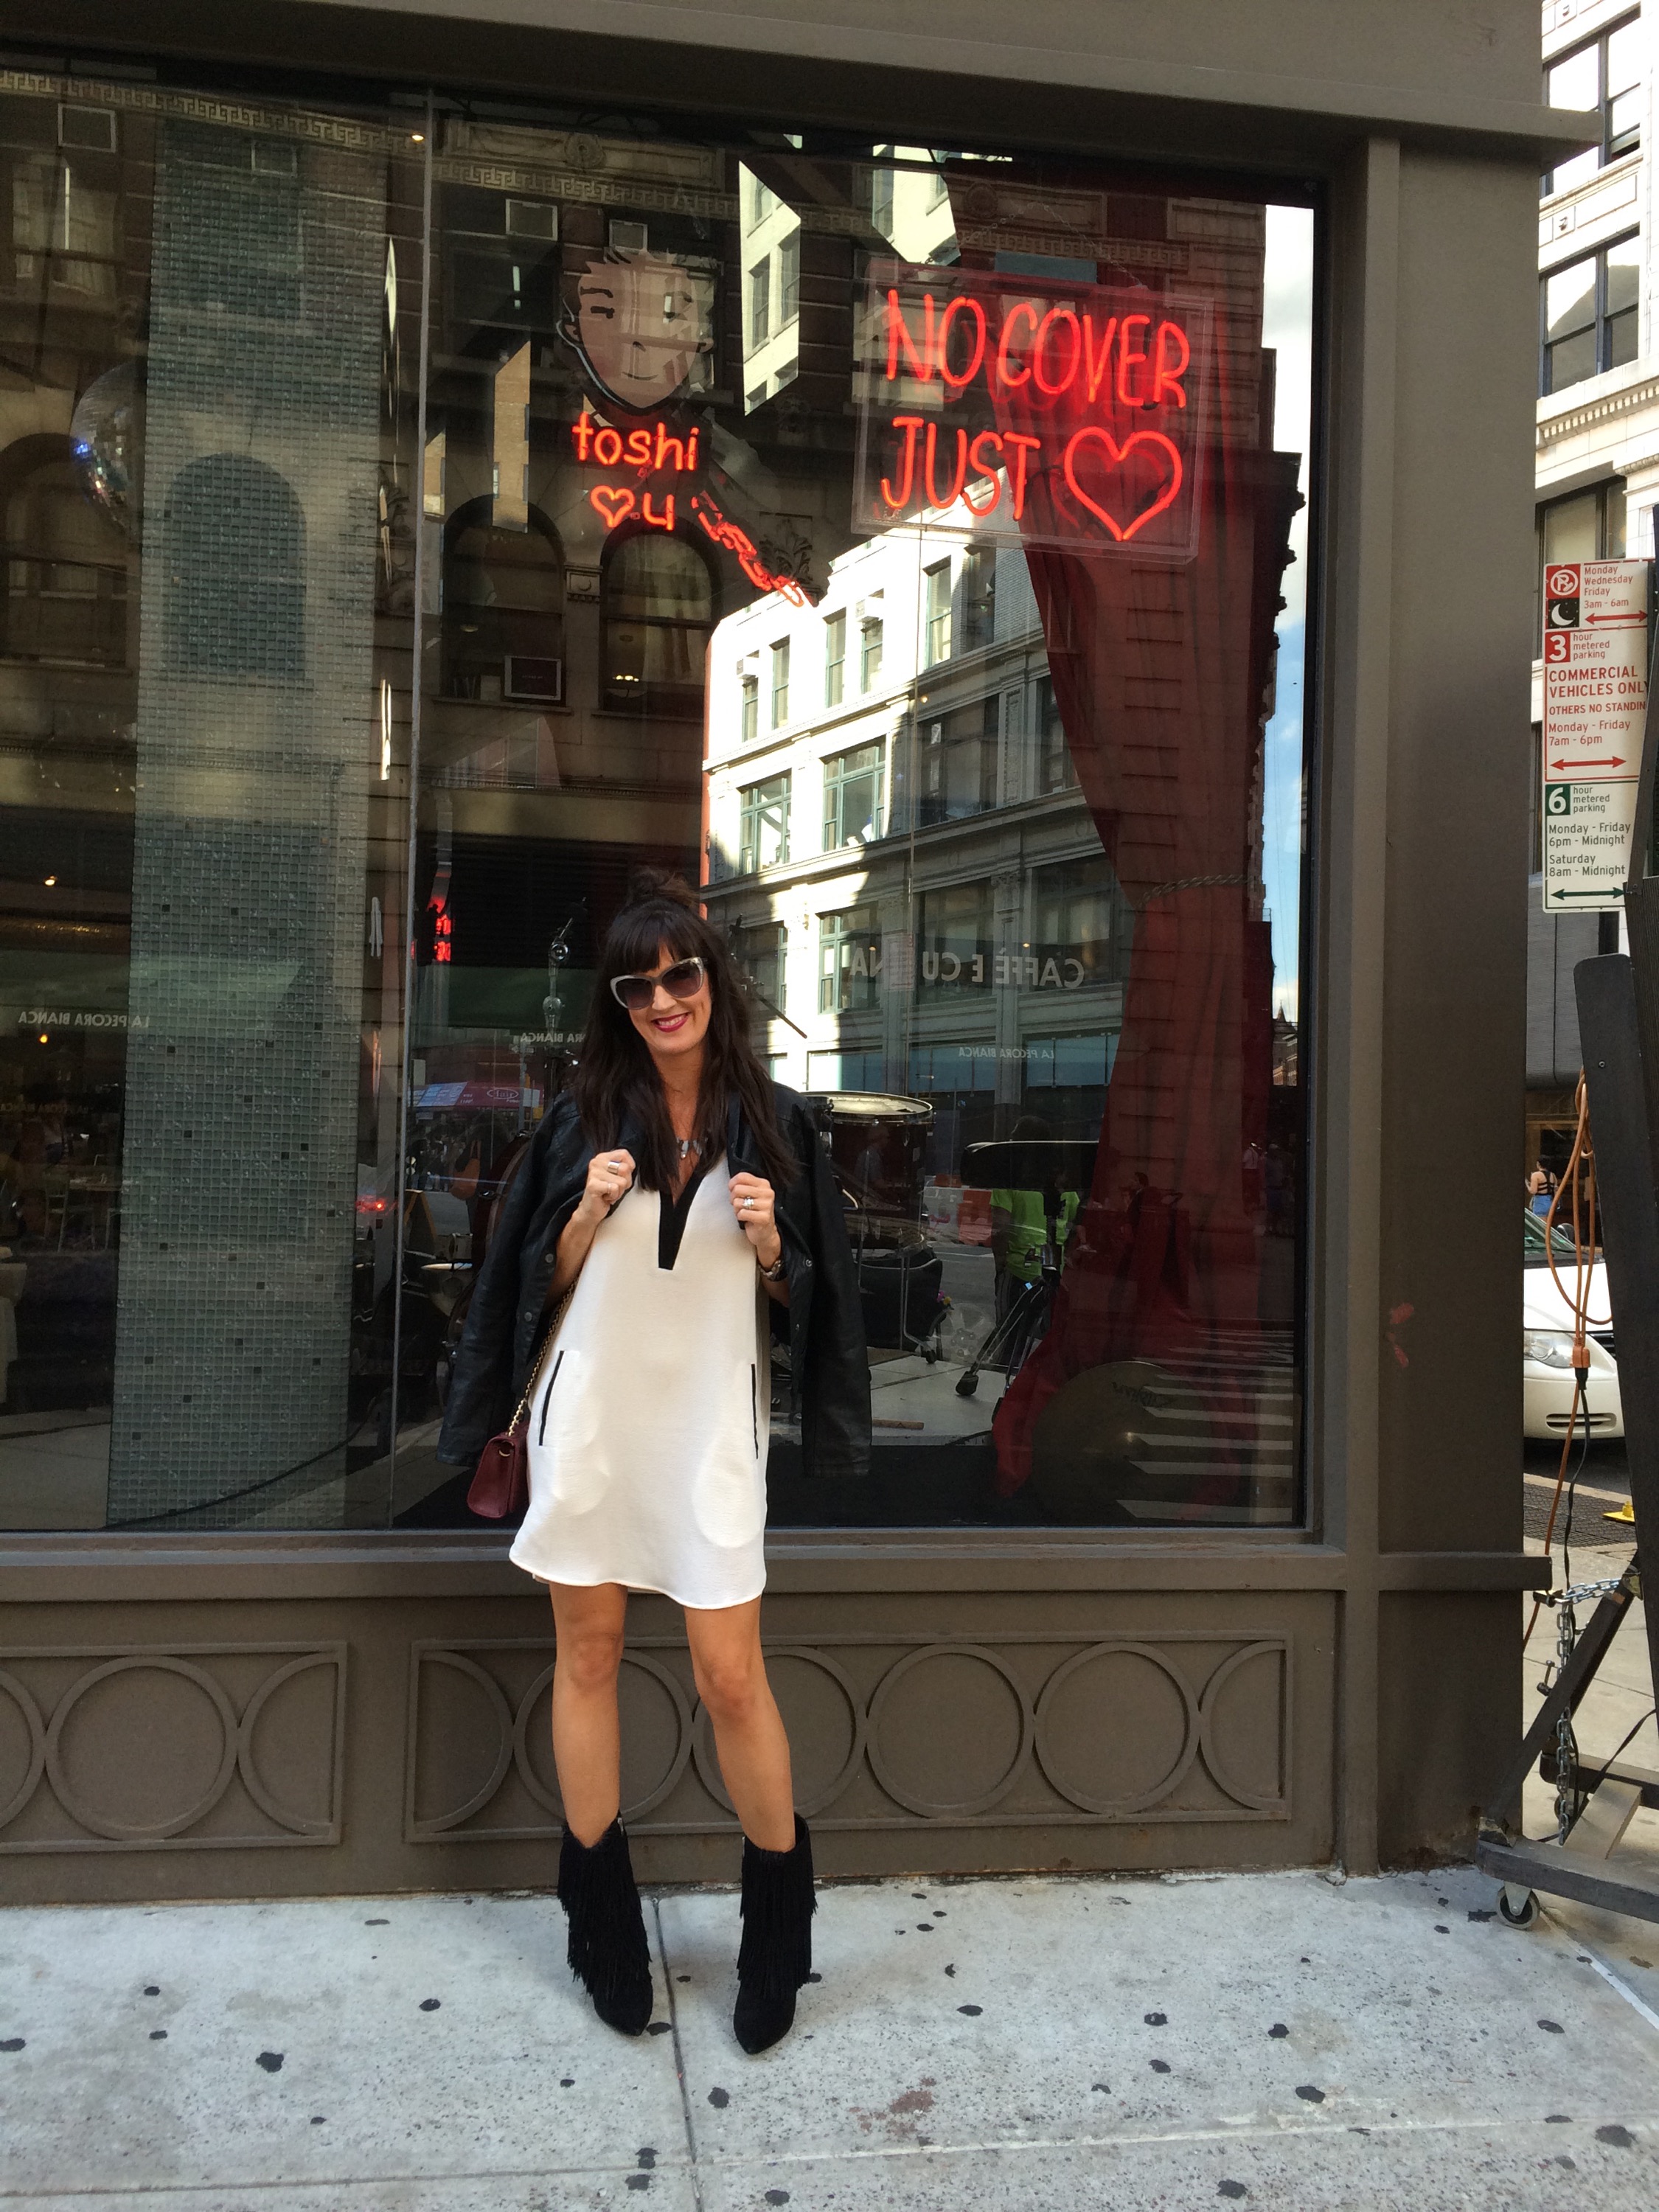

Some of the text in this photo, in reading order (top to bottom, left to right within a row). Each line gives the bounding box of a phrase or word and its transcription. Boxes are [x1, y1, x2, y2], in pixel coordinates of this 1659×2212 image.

[886, 288, 1190, 408] NO COVER
[571, 411, 700, 470] toshi
[881, 416, 1041, 521] JUST
[1585, 566, 1618, 575] Monday
[1585, 575, 1633, 585] Wednesday
[1584, 588, 1610, 597] Friday
[1584, 600, 1602, 609] 3am
[1610, 599, 1629, 607] 6am
[1573, 633, 1593, 641] hour
[1549, 634, 1567, 661] 3
[1573, 640, 1610, 650] metered
[1573, 650, 1605, 661] parking
[1549, 666, 1638, 682] COMMERCIAL
[1549, 683, 1613, 698] VEHICLES
[1549, 701, 1646, 715] OTHERS NO STANDIN
[1548, 722, 1588, 733] Monday
[1599, 720, 1631, 731] Friday
[1549, 737, 1570, 746] 7am
[1580, 734, 1602, 746] 6pm
[1548, 787, 1567, 813] 6
[1573, 794, 1610, 803] metered
[1573, 804, 1605, 814] parking
[1549, 824, 1588, 835] Monday
[1599, 822, 1631, 834] Friday
[1549, 837, 1571, 848] 6pm
[1582, 835, 1625, 846] Midnight
[1549, 854, 1596, 865] Saturday
[1549, 867, 1571, 877] 8am
[1582, 865, 1625, 877] Midnight
